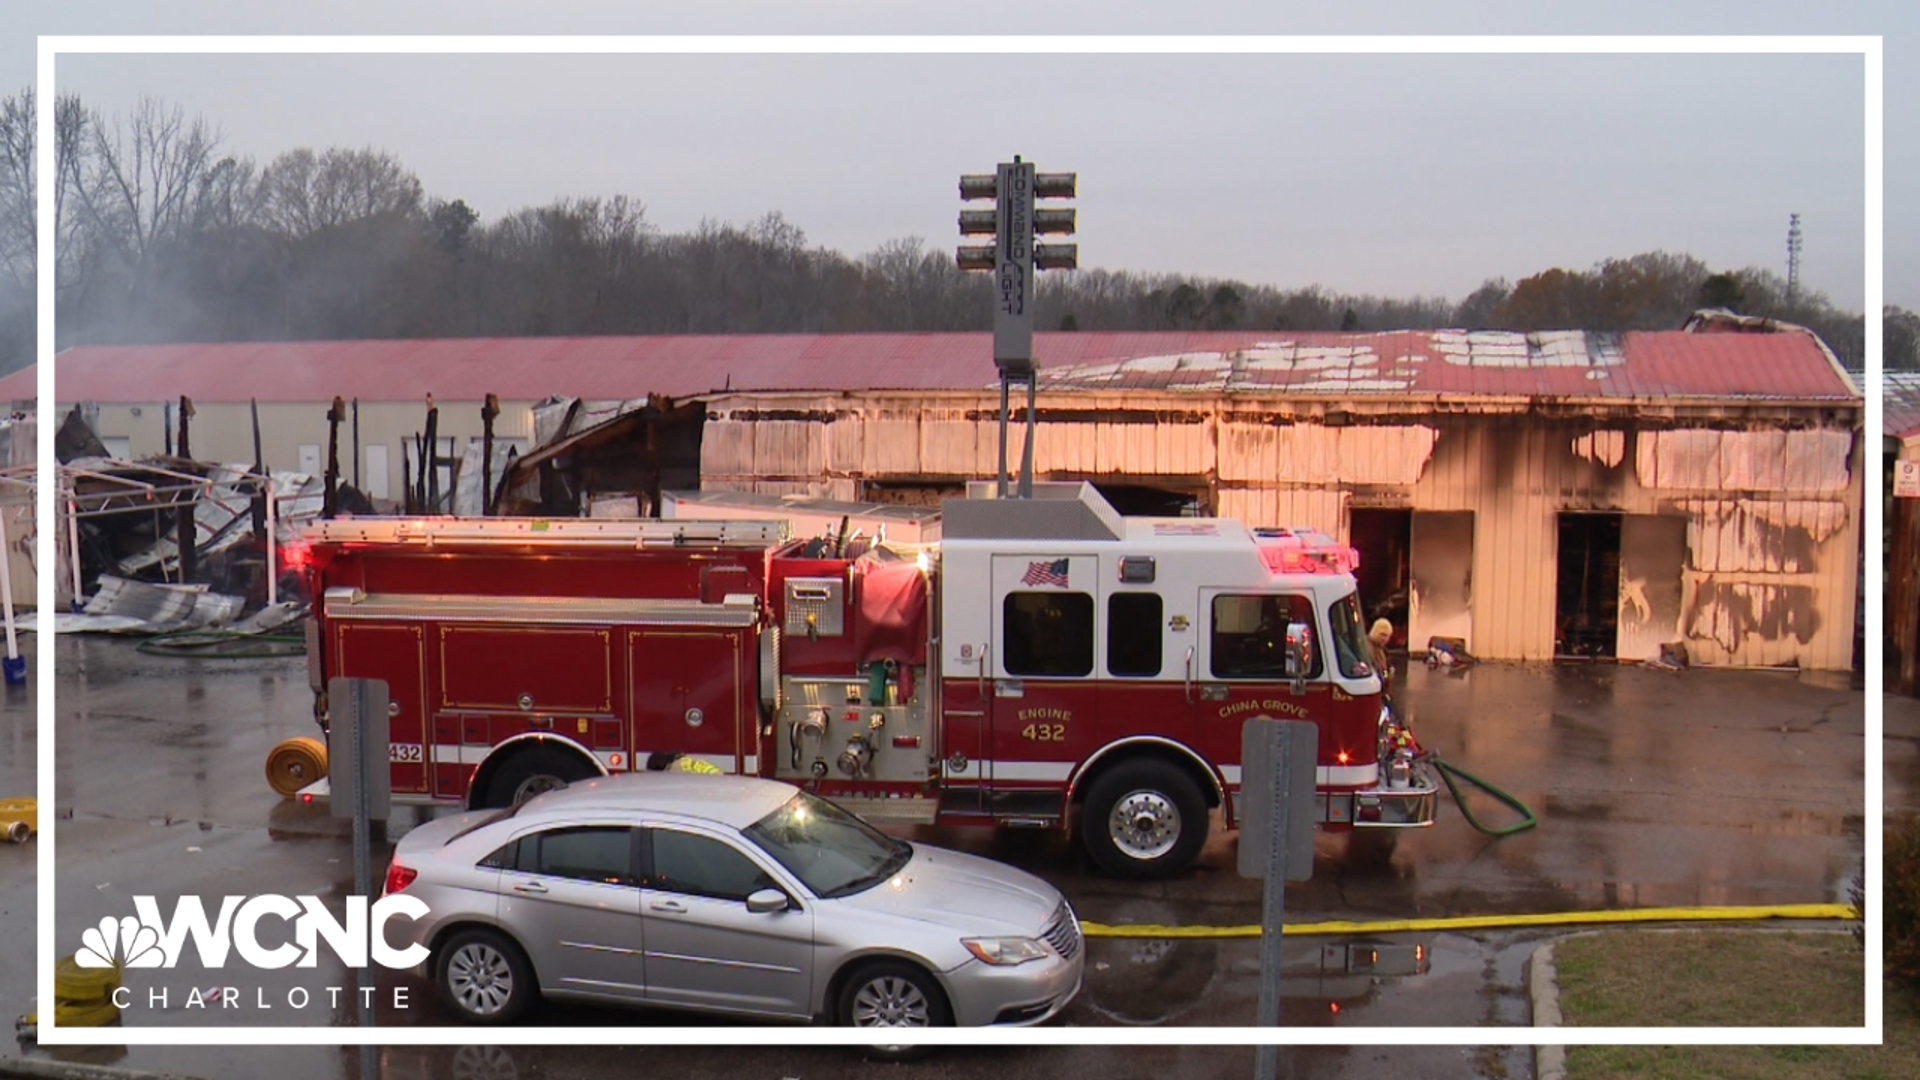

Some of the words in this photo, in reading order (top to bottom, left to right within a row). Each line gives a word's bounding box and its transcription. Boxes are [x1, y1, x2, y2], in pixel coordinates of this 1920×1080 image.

[1001, 262, 1012, 315] LIGHT
[1018, 708, 1072, 721] ENGINE
[1219, 699, 1260, 718] CHINA
[1262, 699, 1308, 718] GROVE
[1022, 723, 1065, 740] 432
[389, 744, 421, 760] 432
